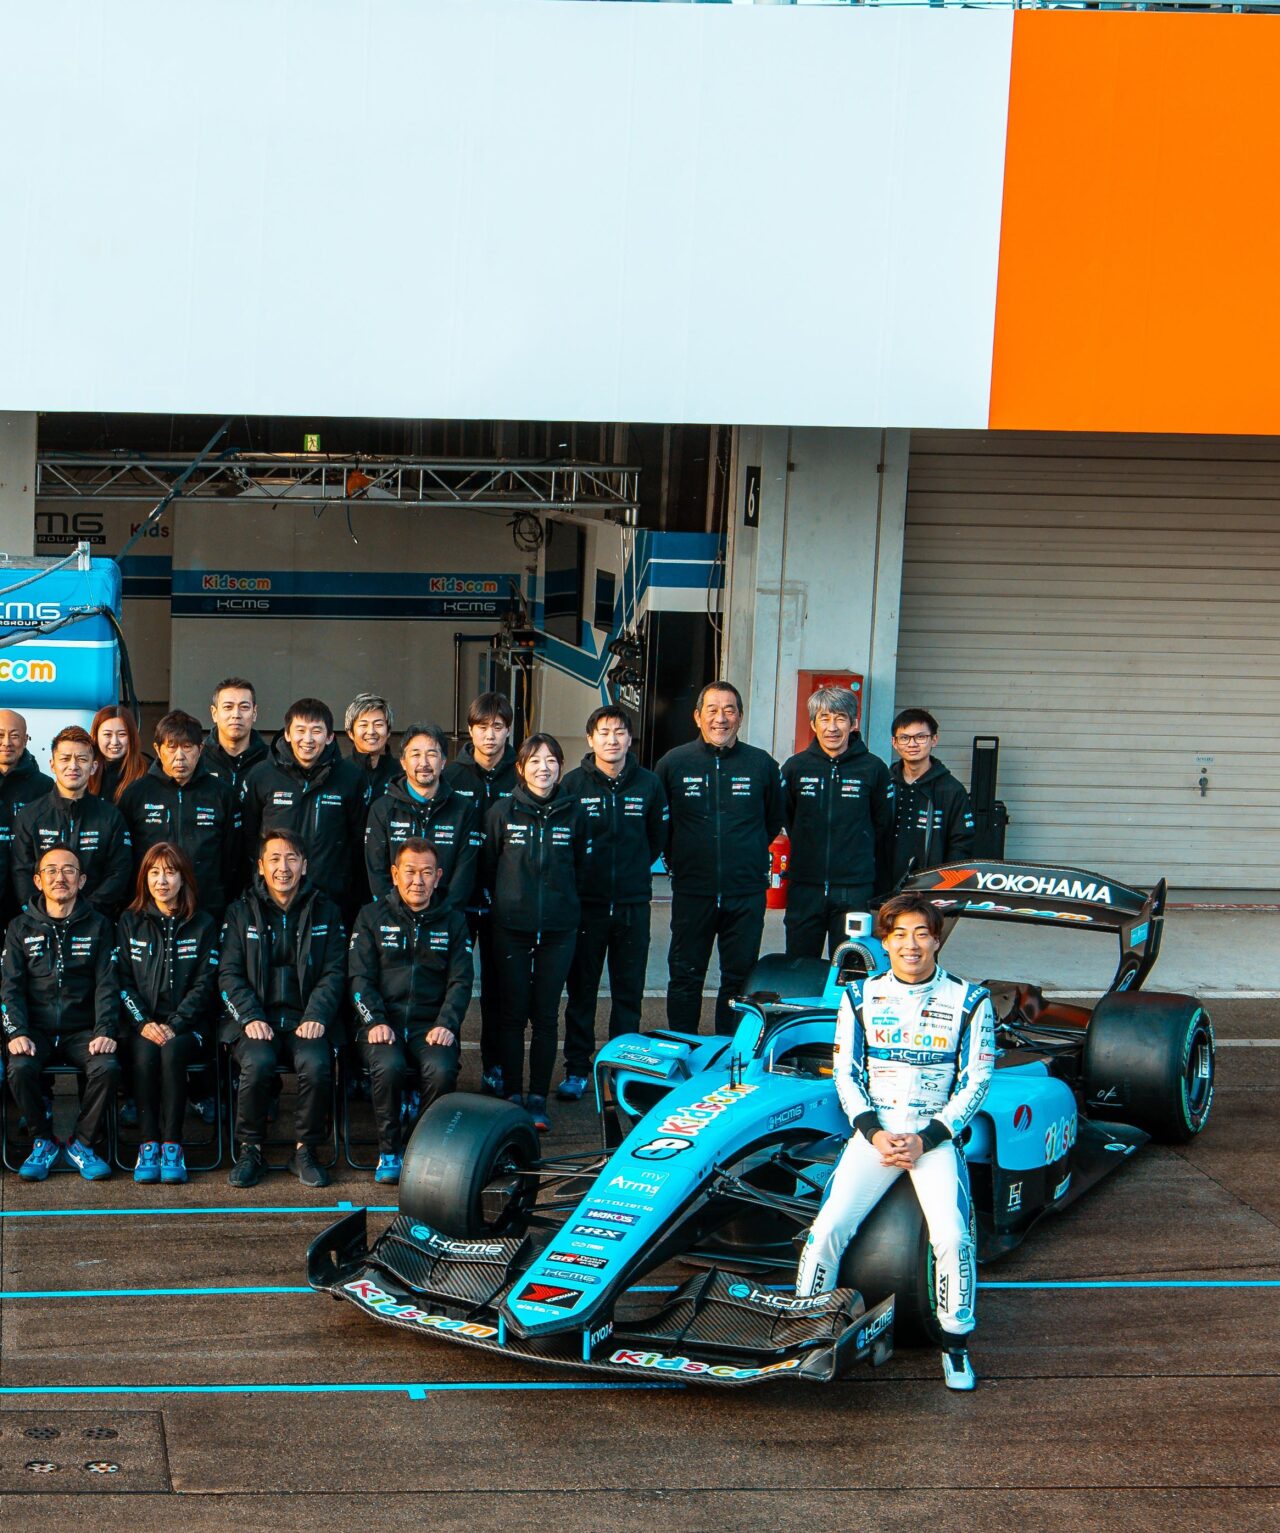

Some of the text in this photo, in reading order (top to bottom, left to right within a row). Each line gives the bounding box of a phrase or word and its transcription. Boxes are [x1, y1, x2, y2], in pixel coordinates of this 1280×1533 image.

[747, 476, 755, 518] 6
[216, 599, 270, 609] KCMG
[443, 601, 497, 612] KCMG
[976, 872, 1112, 904] YOKOHAMA
[890, 1049, 945, 1061] KCMG
[609, 1176, 660, 1195] Arms
[575, 1226, 622, 1238] HRX
[429, 1234, 505, 1252] KCMG
[549, 1254, 577, 1263] GR
[544, 1269, 597, 1282] KCMG
[750, 1290, 832, 1307] KCMG
[865, 1306, 893, 1340] KCMG
